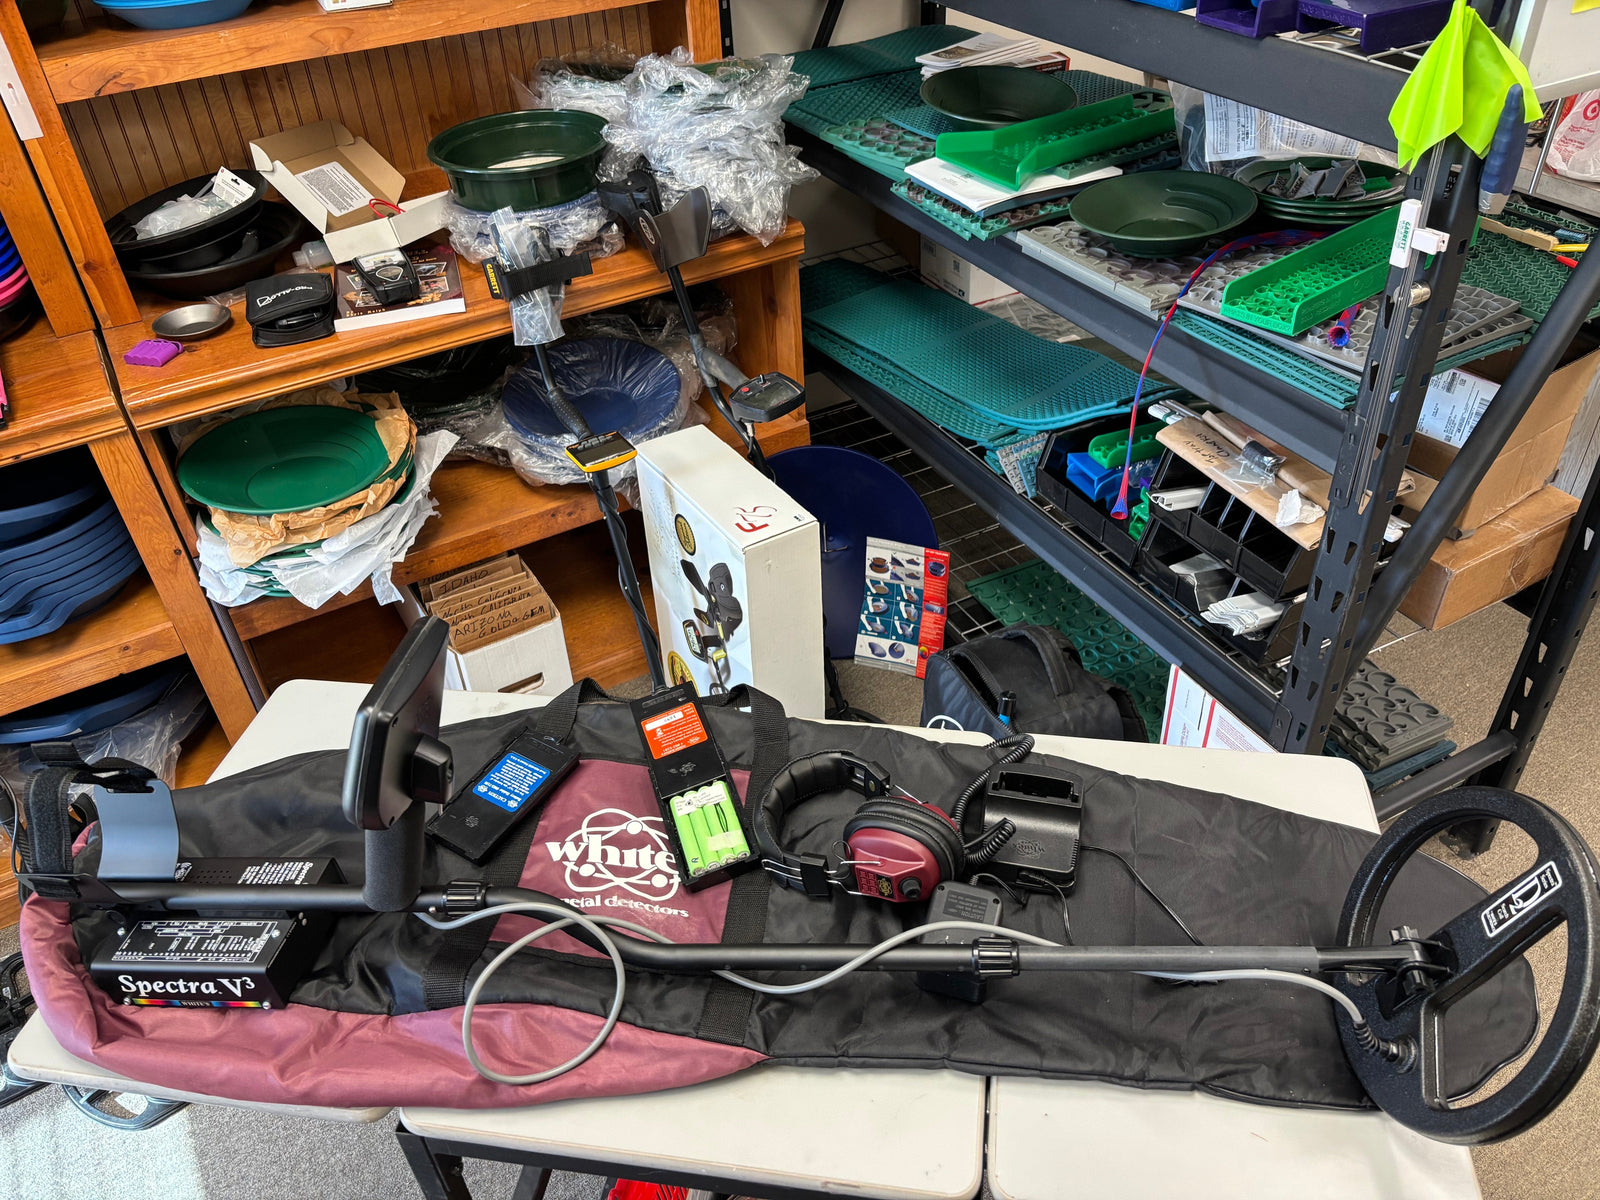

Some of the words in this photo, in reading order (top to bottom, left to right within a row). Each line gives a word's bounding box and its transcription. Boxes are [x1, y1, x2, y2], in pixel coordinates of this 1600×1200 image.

[486, 263, 500, 294] GARRETT
[440, 569, 489, 594] IDAHO
[522, 606, 545, 620] GEM
[545, 834, 679, 875] white
[604, 895, 690, 918] detectors
[118, 974, 217, 997] Spectra
